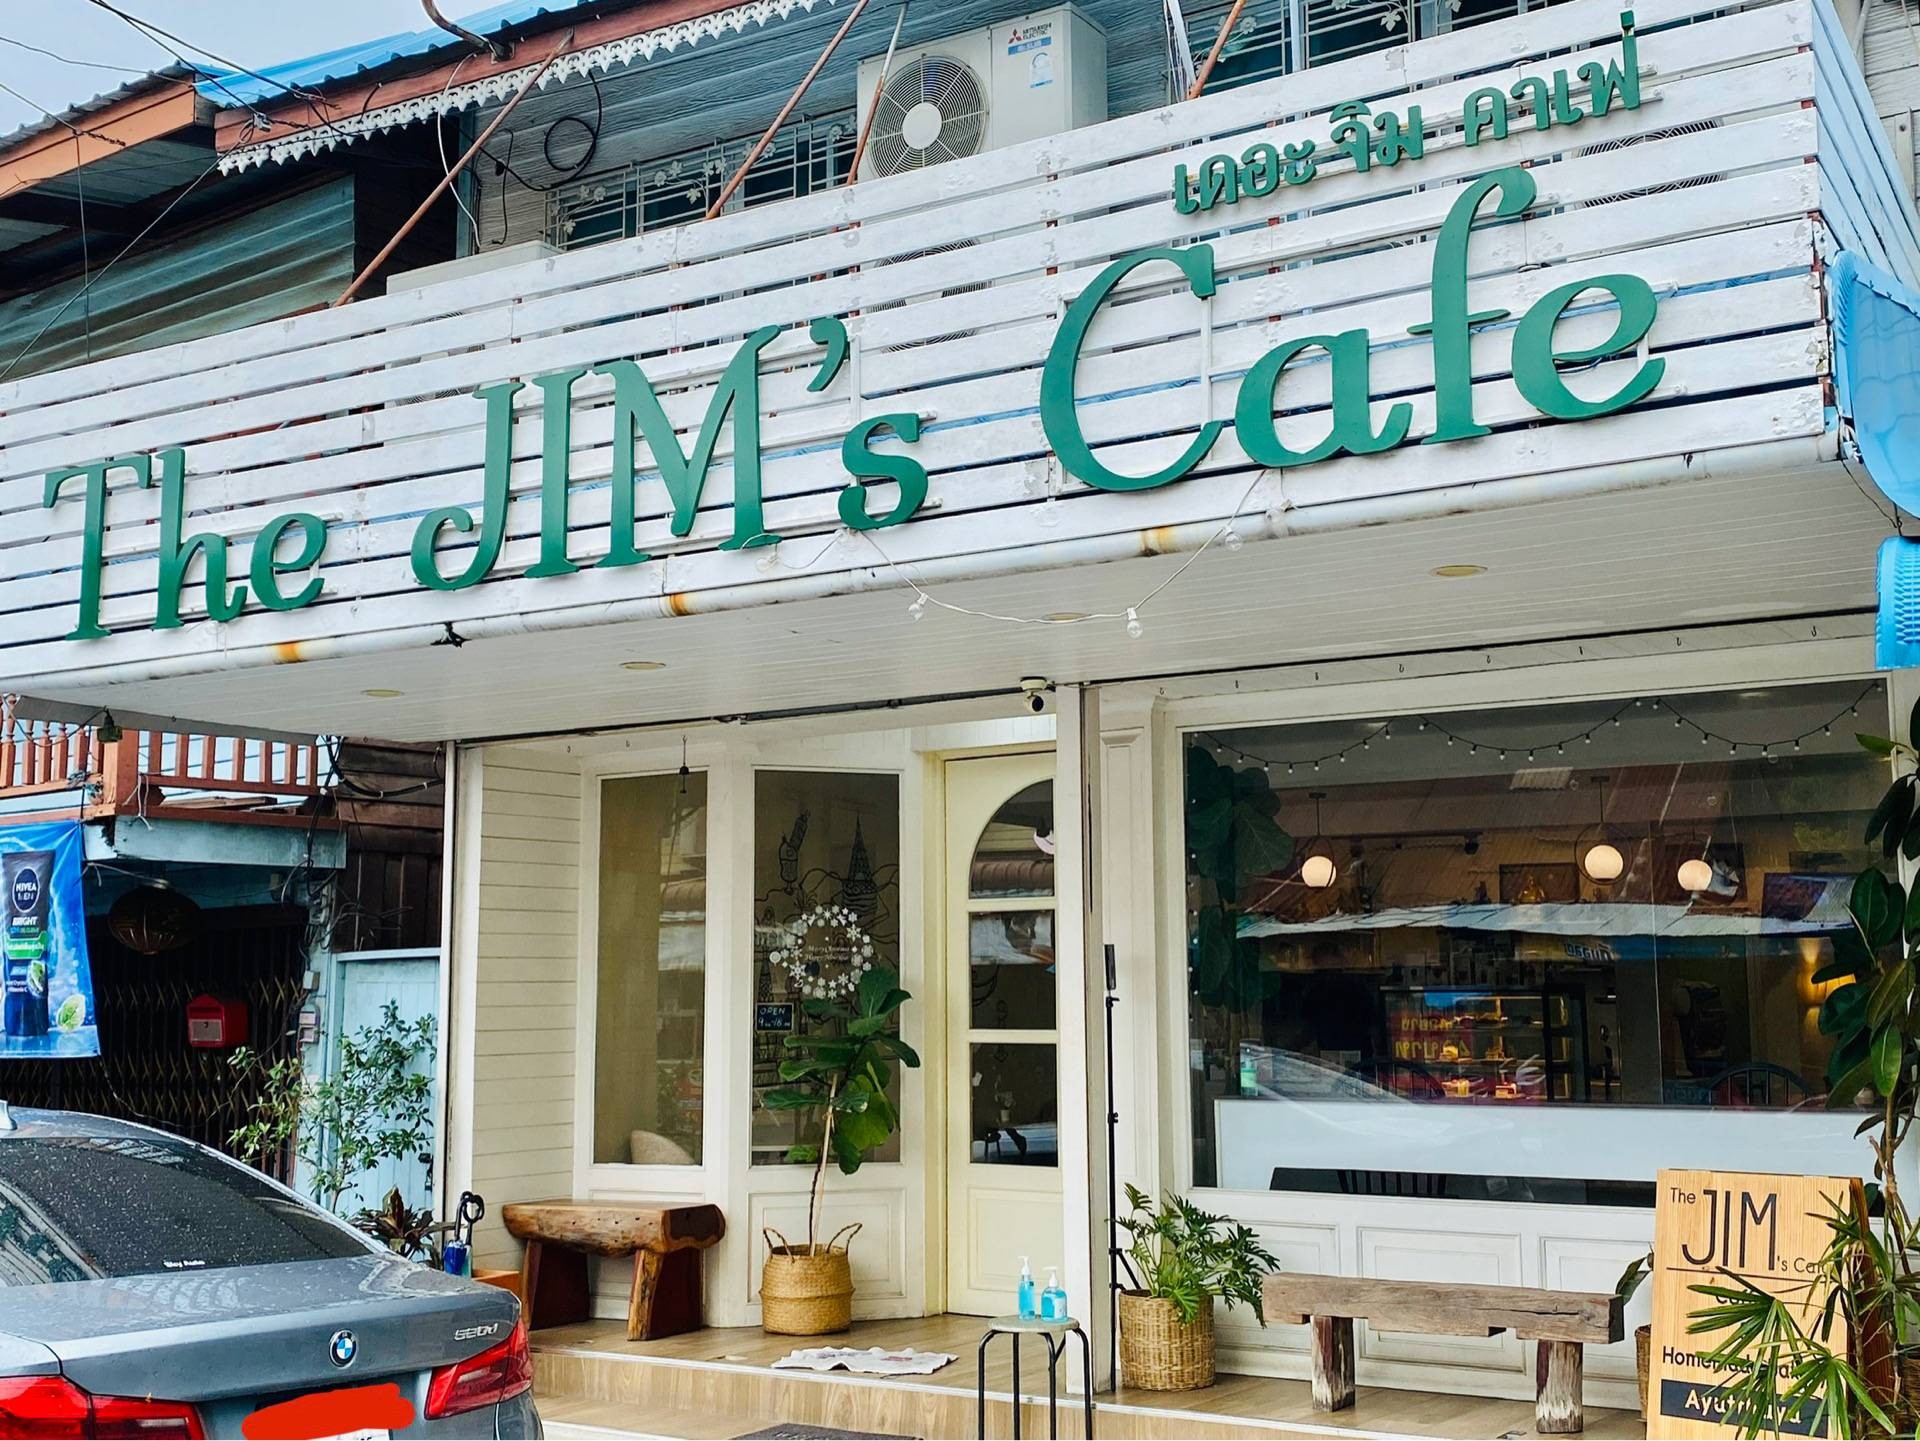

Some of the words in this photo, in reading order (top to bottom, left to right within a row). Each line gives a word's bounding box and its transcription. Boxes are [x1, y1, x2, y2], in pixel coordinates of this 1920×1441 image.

[1174, 139, 1317, 215] เดอะ
[1329, 101, 1425, 173] จิม
[1463, 9, 1642, 146] คาเฟ่
[43, 447, 329, 642] The
[1039, 164, 1668, 494] Cafe
[15, 882, 37, 892] NIVEA
[760, 1006, 786, 1016] OPEN
[1670, 1187, 1696, 1204] The
